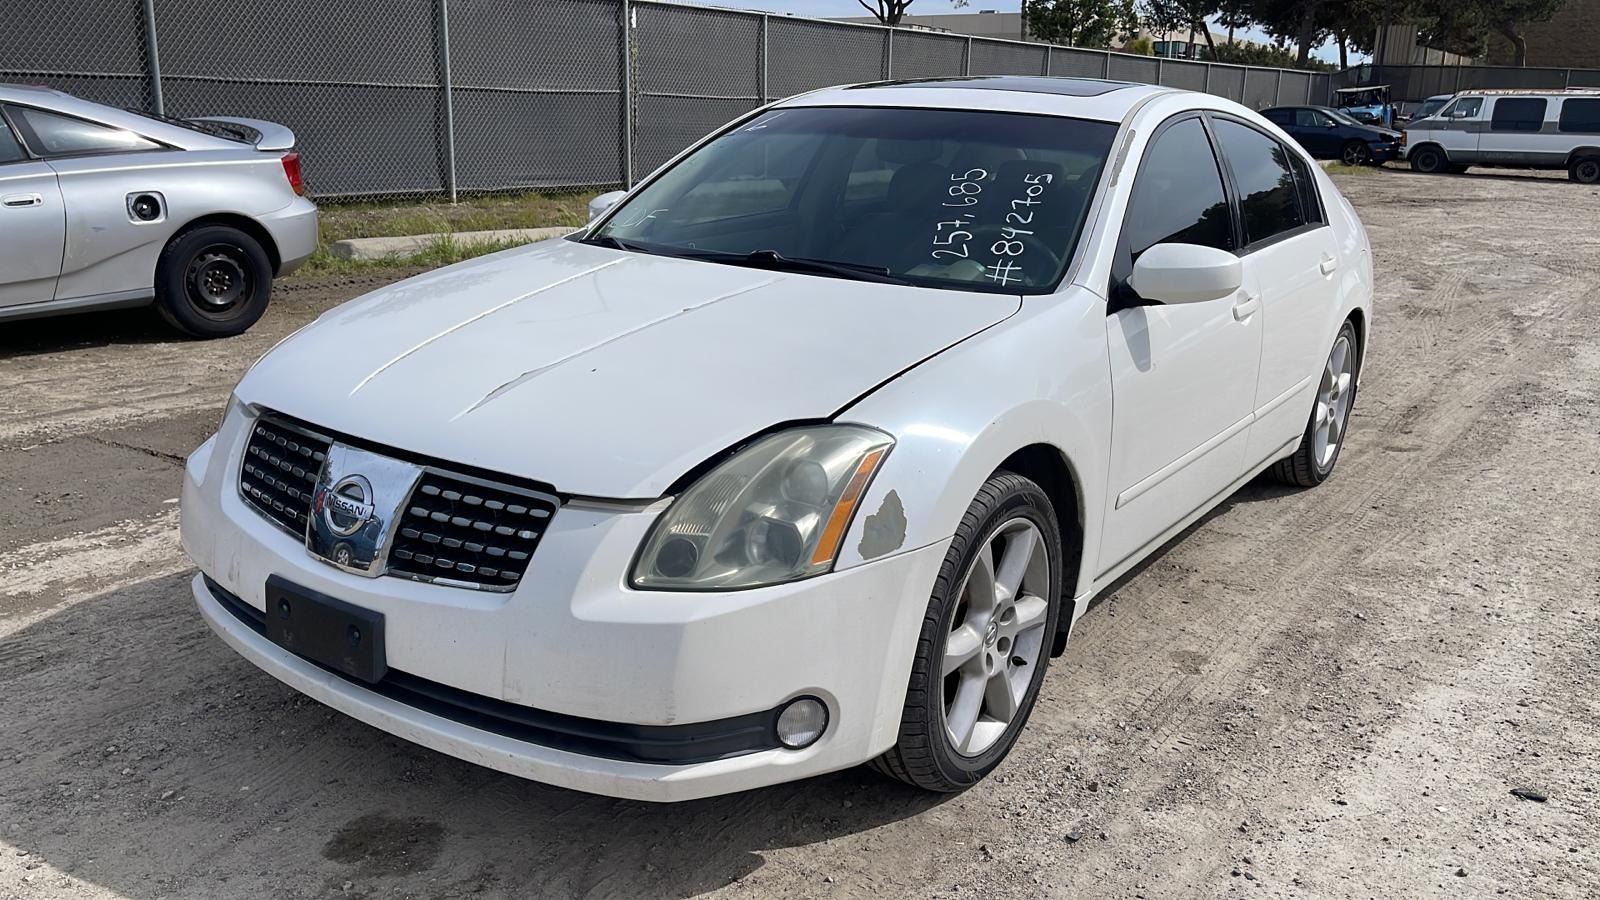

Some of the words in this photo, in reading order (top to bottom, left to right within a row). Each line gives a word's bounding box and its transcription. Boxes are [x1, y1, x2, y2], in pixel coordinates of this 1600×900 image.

[931, 168, 988, 259] 257,685
[985, 173, 1053, 287] #842705
[326, 493, 365, 516] NISSAN
